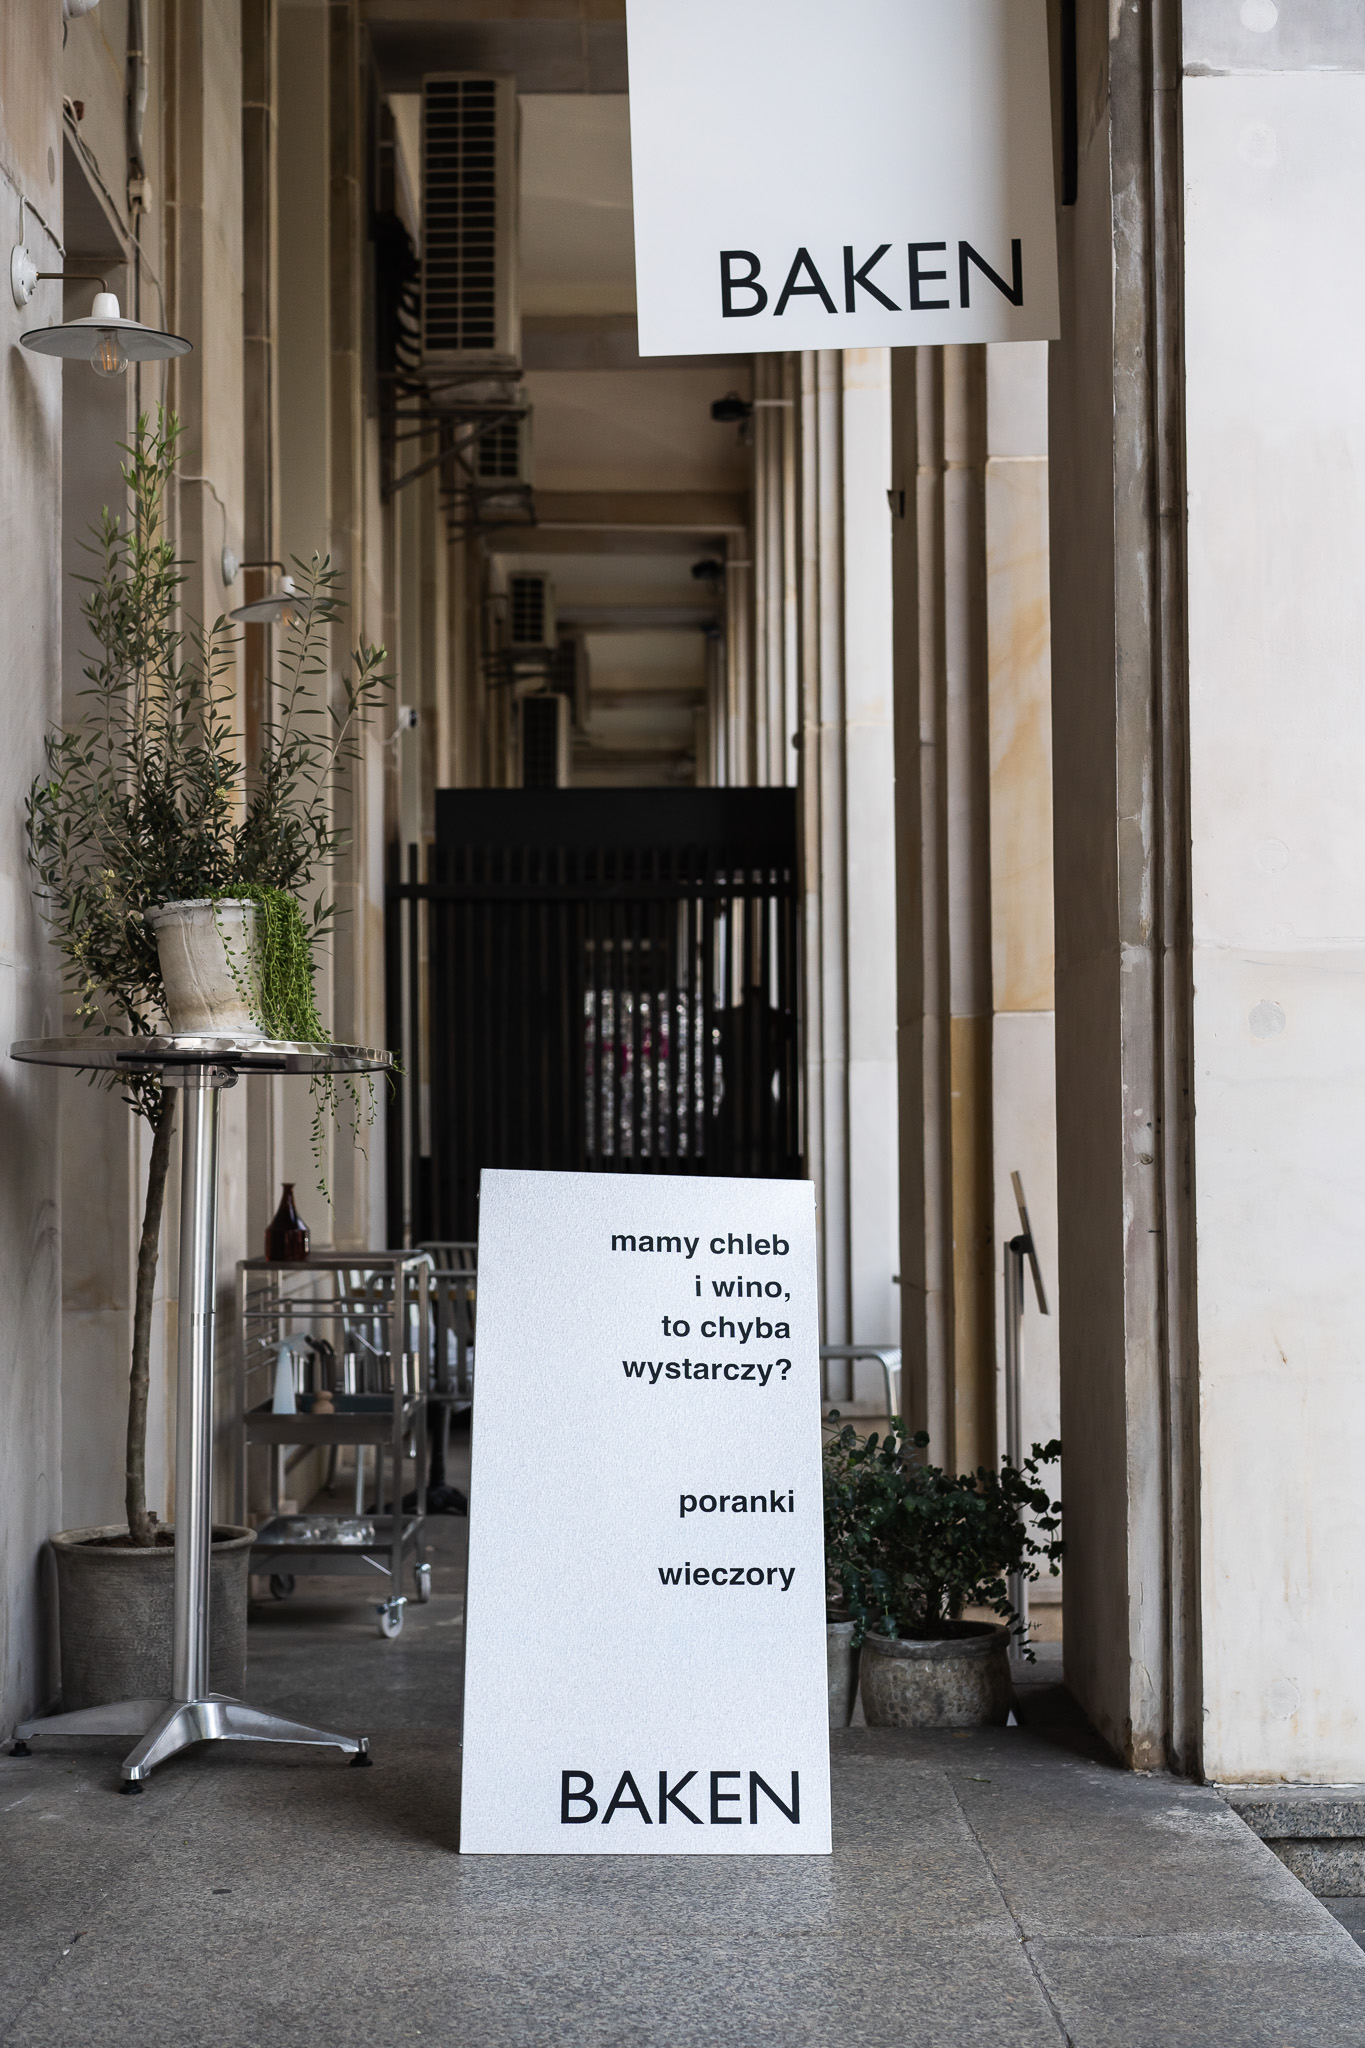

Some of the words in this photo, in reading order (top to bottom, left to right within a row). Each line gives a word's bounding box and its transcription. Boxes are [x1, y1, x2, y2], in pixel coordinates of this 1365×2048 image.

[720, 238, 1025, 318] BAKEN
[611, 1234, 700, 1259] mamy
[709, 1233, 790, 1256] chleb
[695, 1275, 702, 1297] i
[711, 1275, 791, 1303] wino,
[661, 1316, 691, 1338] to
[700, 1316, 791, 1345] chyba
[622, 1358, 792, 1387] wystarczy?
[679, 1489, 795, 1518] poranki
[658, 1562, 796, 1591] wieczory
[560, 1770, 801, 1825] BAKEN
